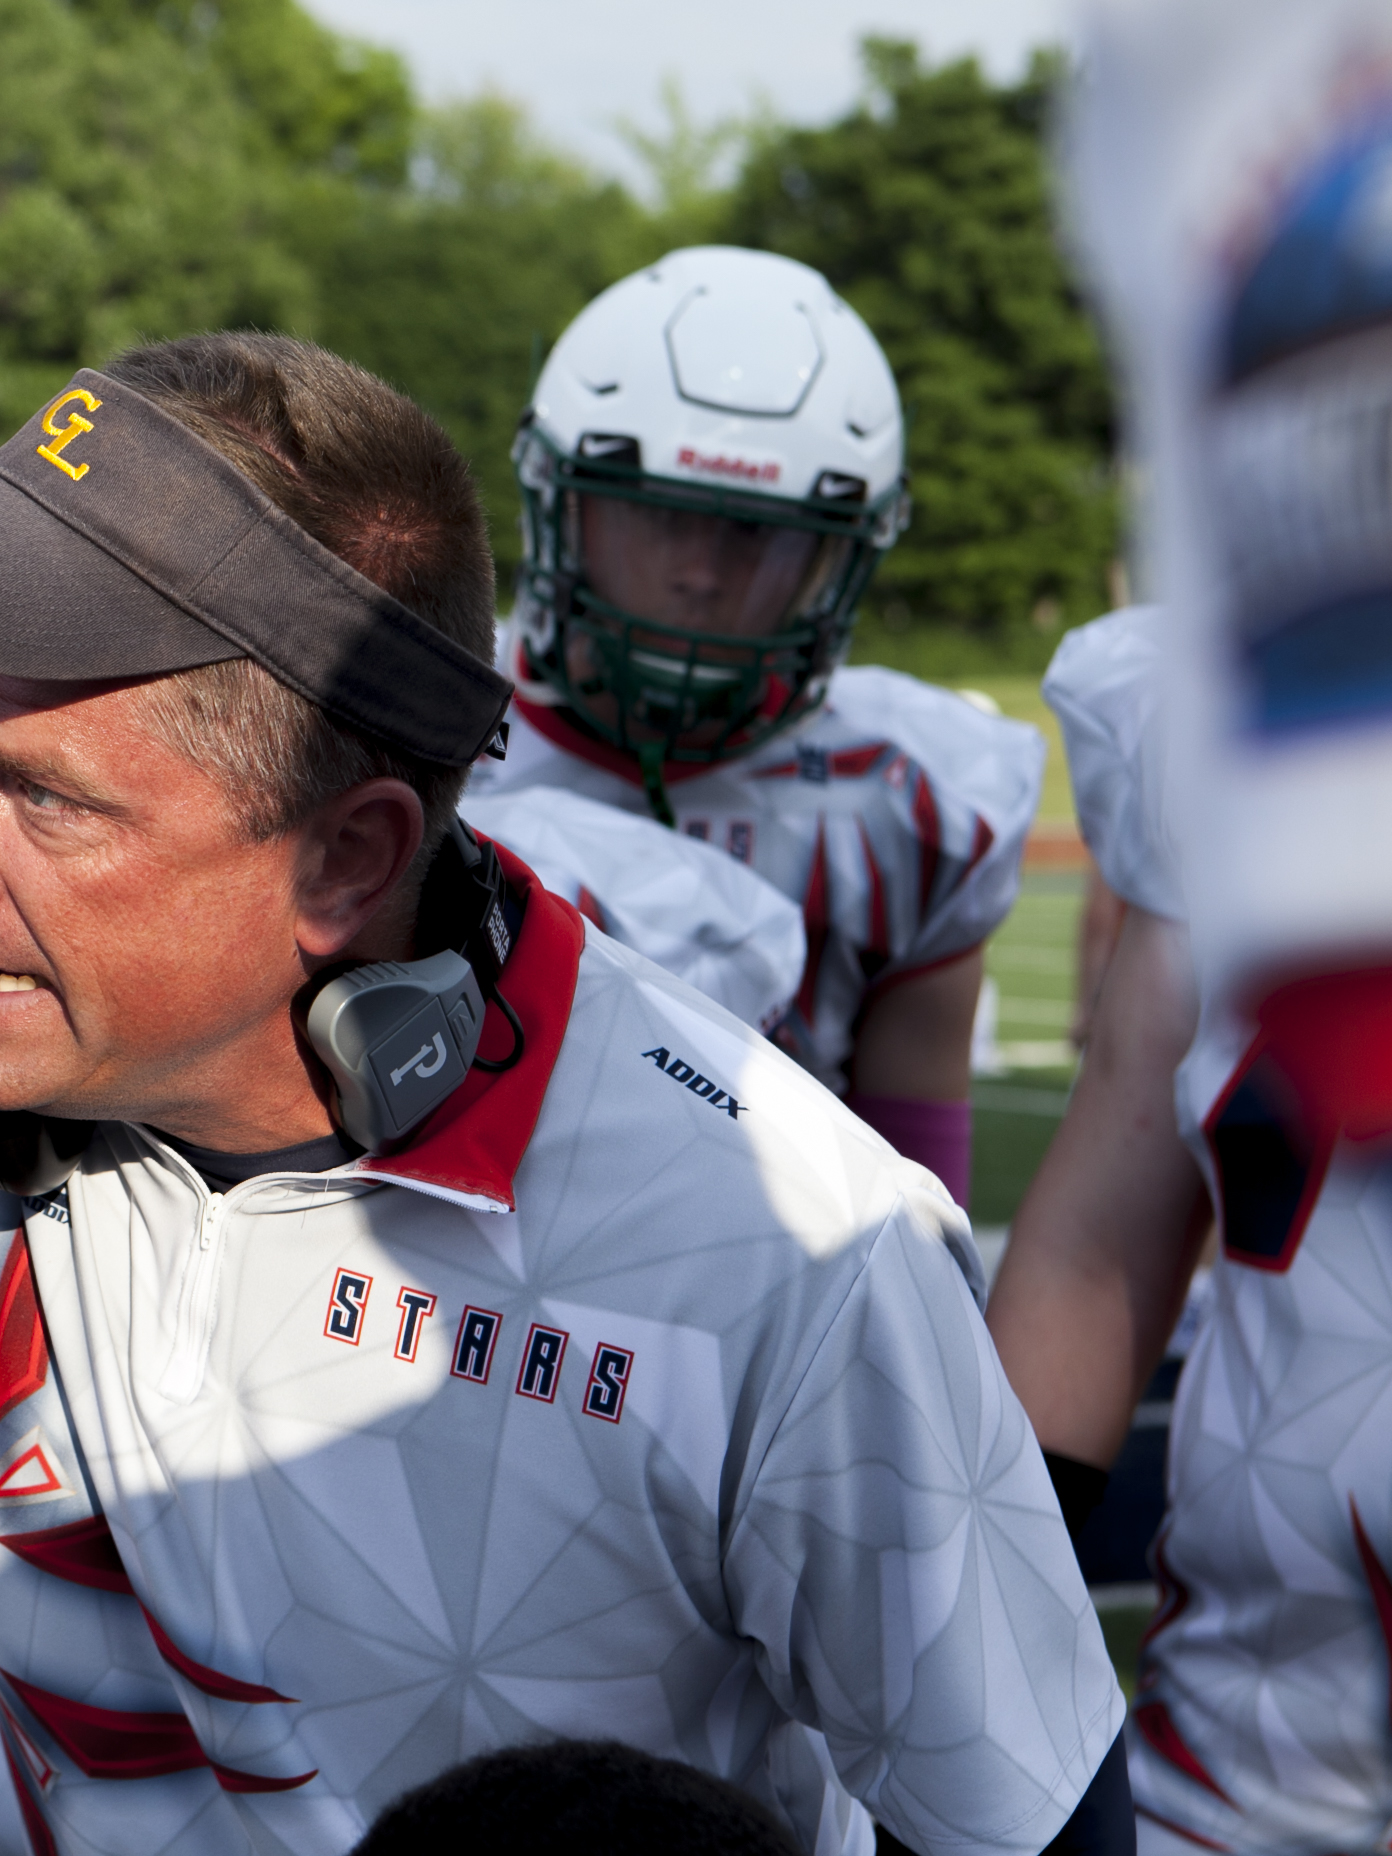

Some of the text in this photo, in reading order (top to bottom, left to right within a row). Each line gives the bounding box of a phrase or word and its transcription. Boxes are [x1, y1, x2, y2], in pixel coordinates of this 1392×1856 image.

[488, 915, 506, 965] PHONE
[493, 902, 510, 951] PORTA
[640, 1046, 750, 1120] ADDIX
[322, 1266, 635, 1425] STARS
